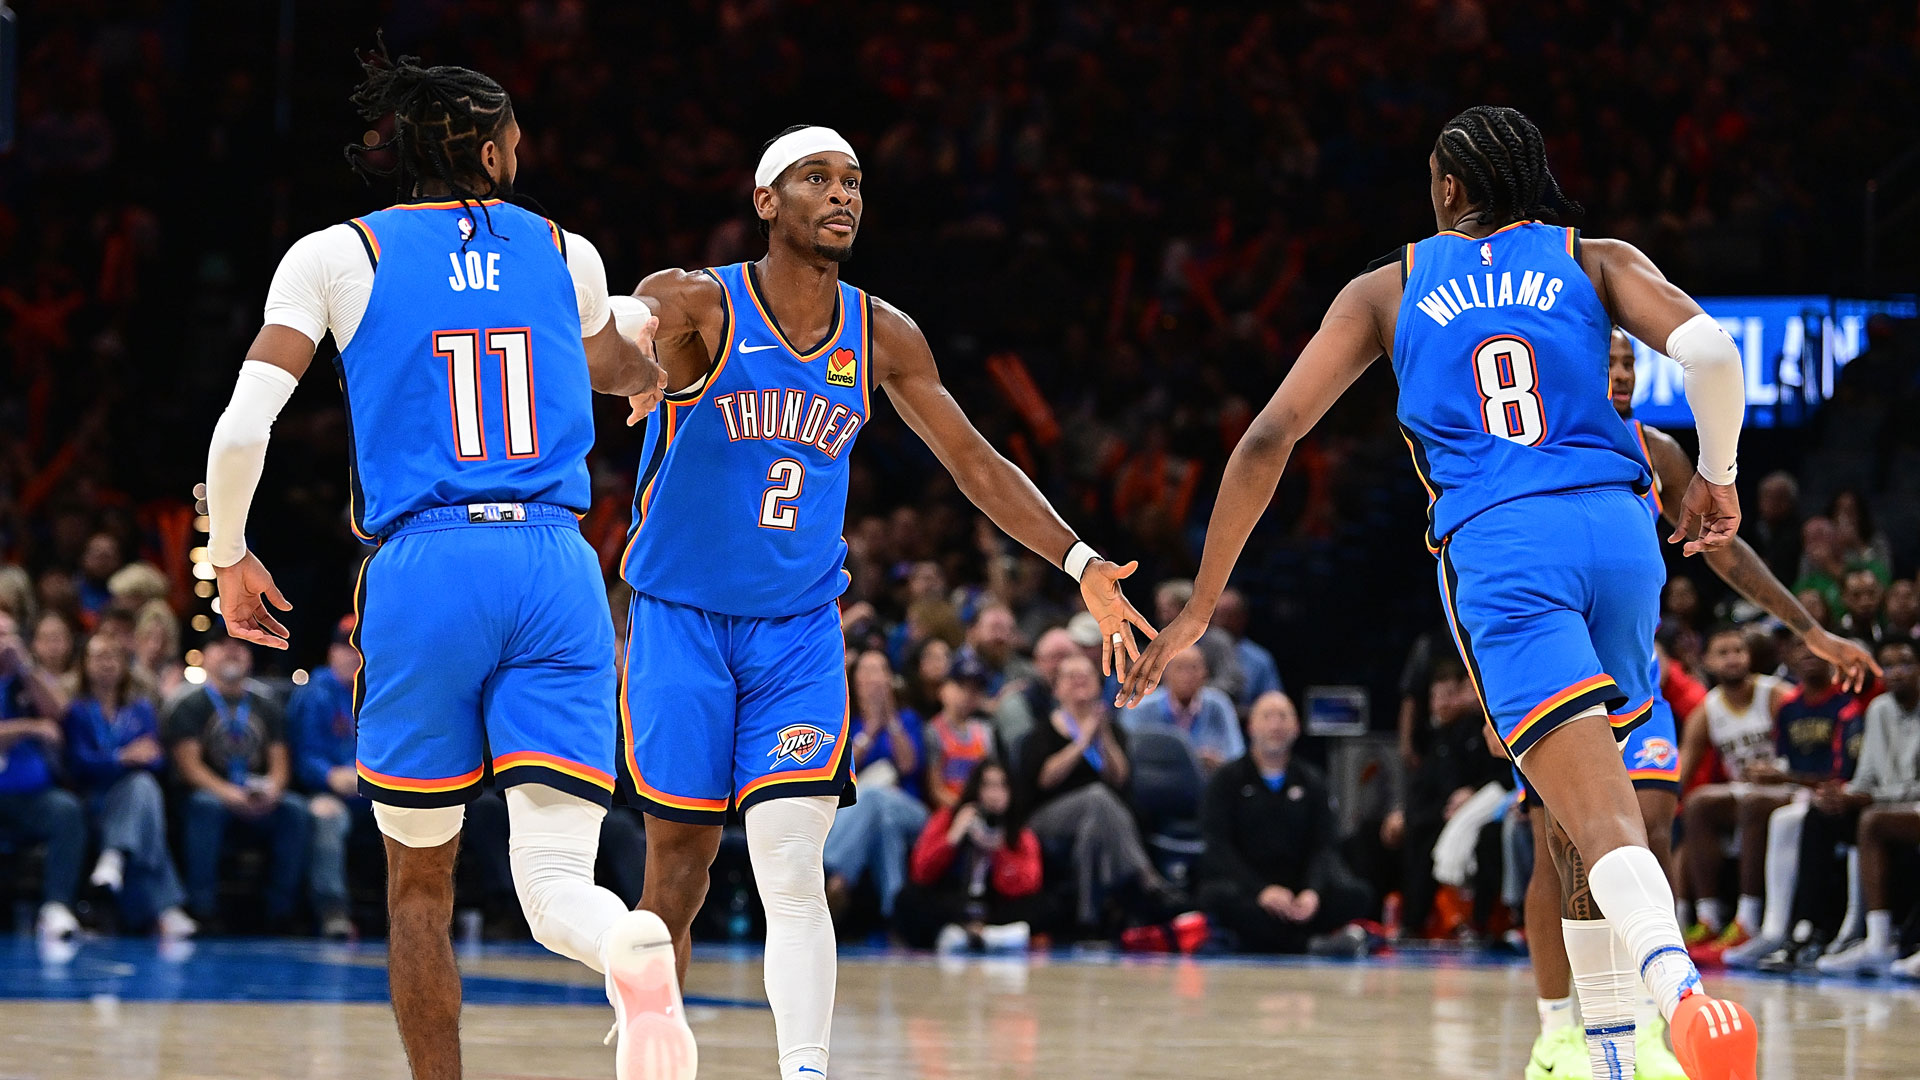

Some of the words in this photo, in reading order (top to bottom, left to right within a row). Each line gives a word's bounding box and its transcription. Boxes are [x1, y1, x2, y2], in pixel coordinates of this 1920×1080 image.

[448, 250, 501, 292] JOE
[1416, 269, 1564, 328] WILLIAMS
[432, 326, 540, 462] 11
[713, 388, 862, 461] THUNDER
[1471, 334, 1548, 448] 8
[758, 457, 806, 532] 2
[779, 732, 816, 758] OKC
